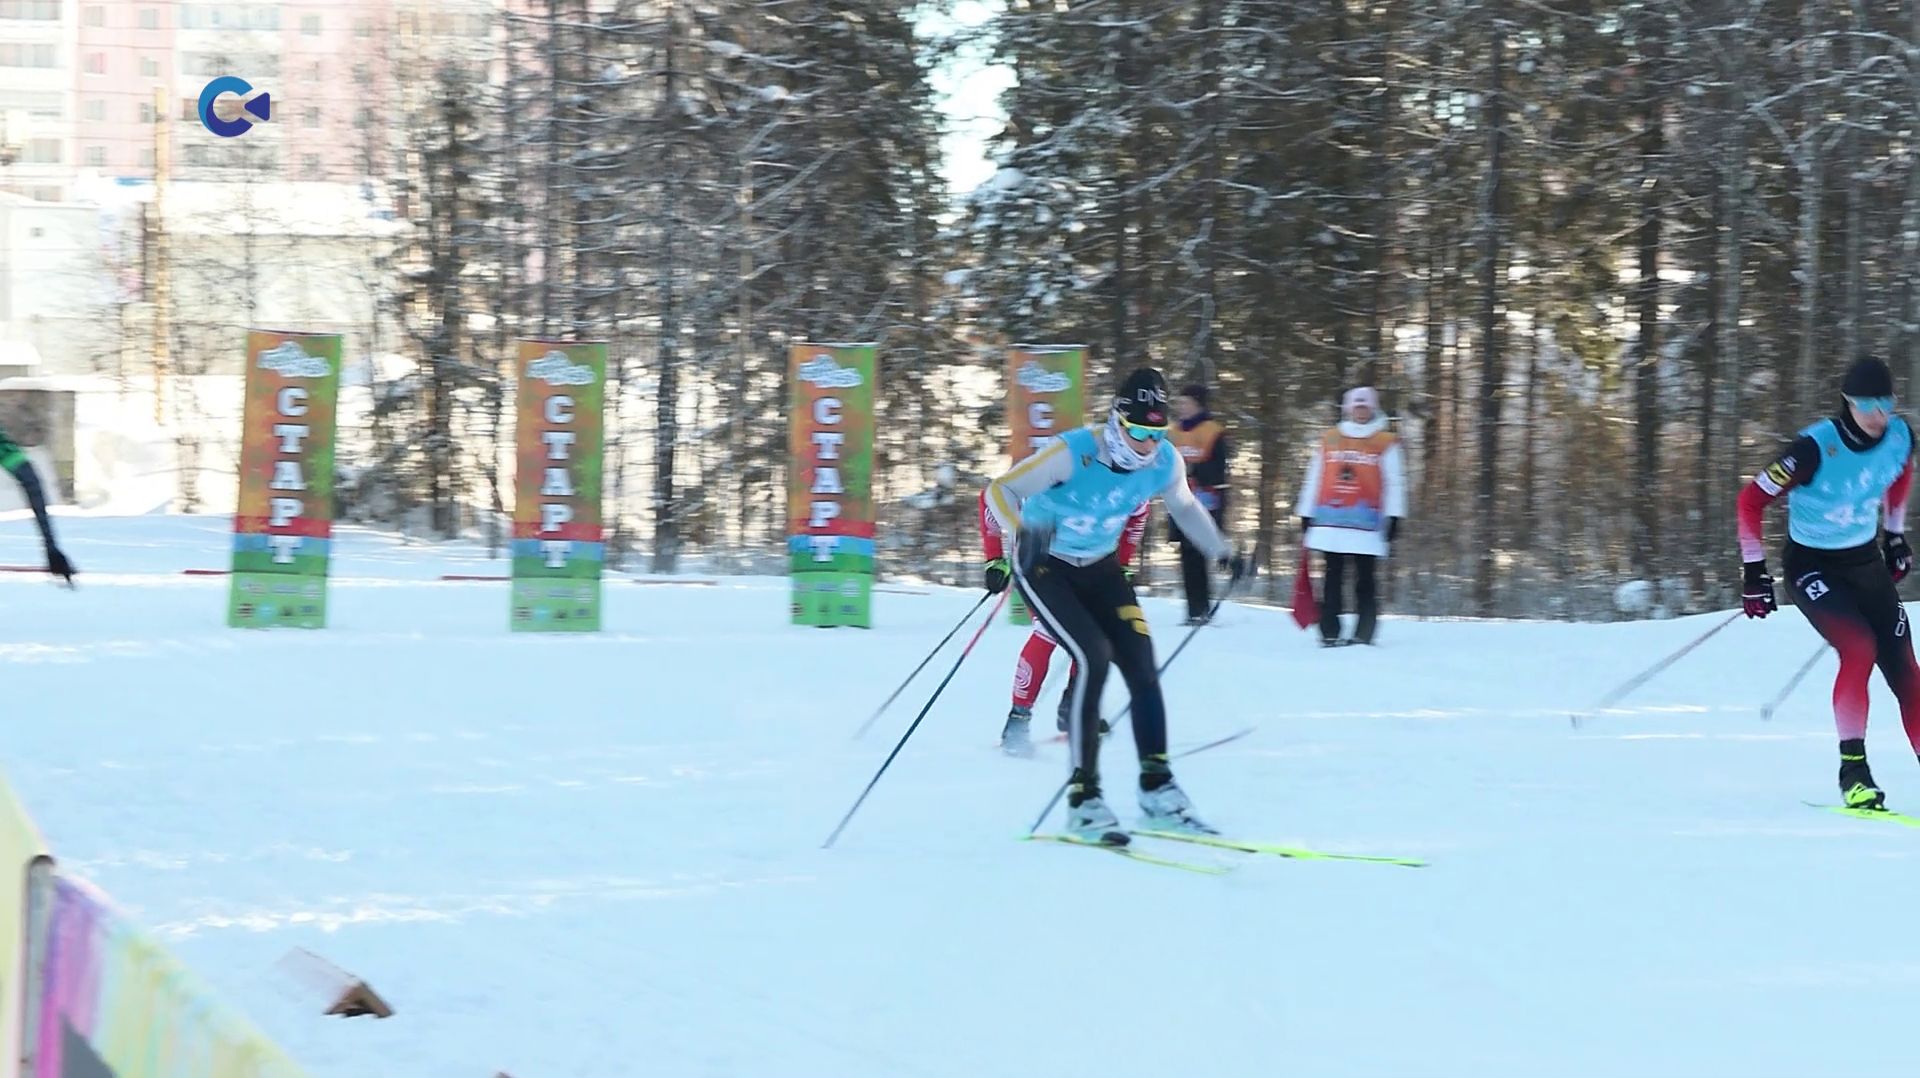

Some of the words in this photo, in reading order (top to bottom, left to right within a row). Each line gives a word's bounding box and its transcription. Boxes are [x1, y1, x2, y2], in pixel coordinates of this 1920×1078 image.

[267, 386, 310, 564] СТАРТ
[540, 395, 577, 568] СТАРТ
[808, 397, 845, 563] СТАРТ
